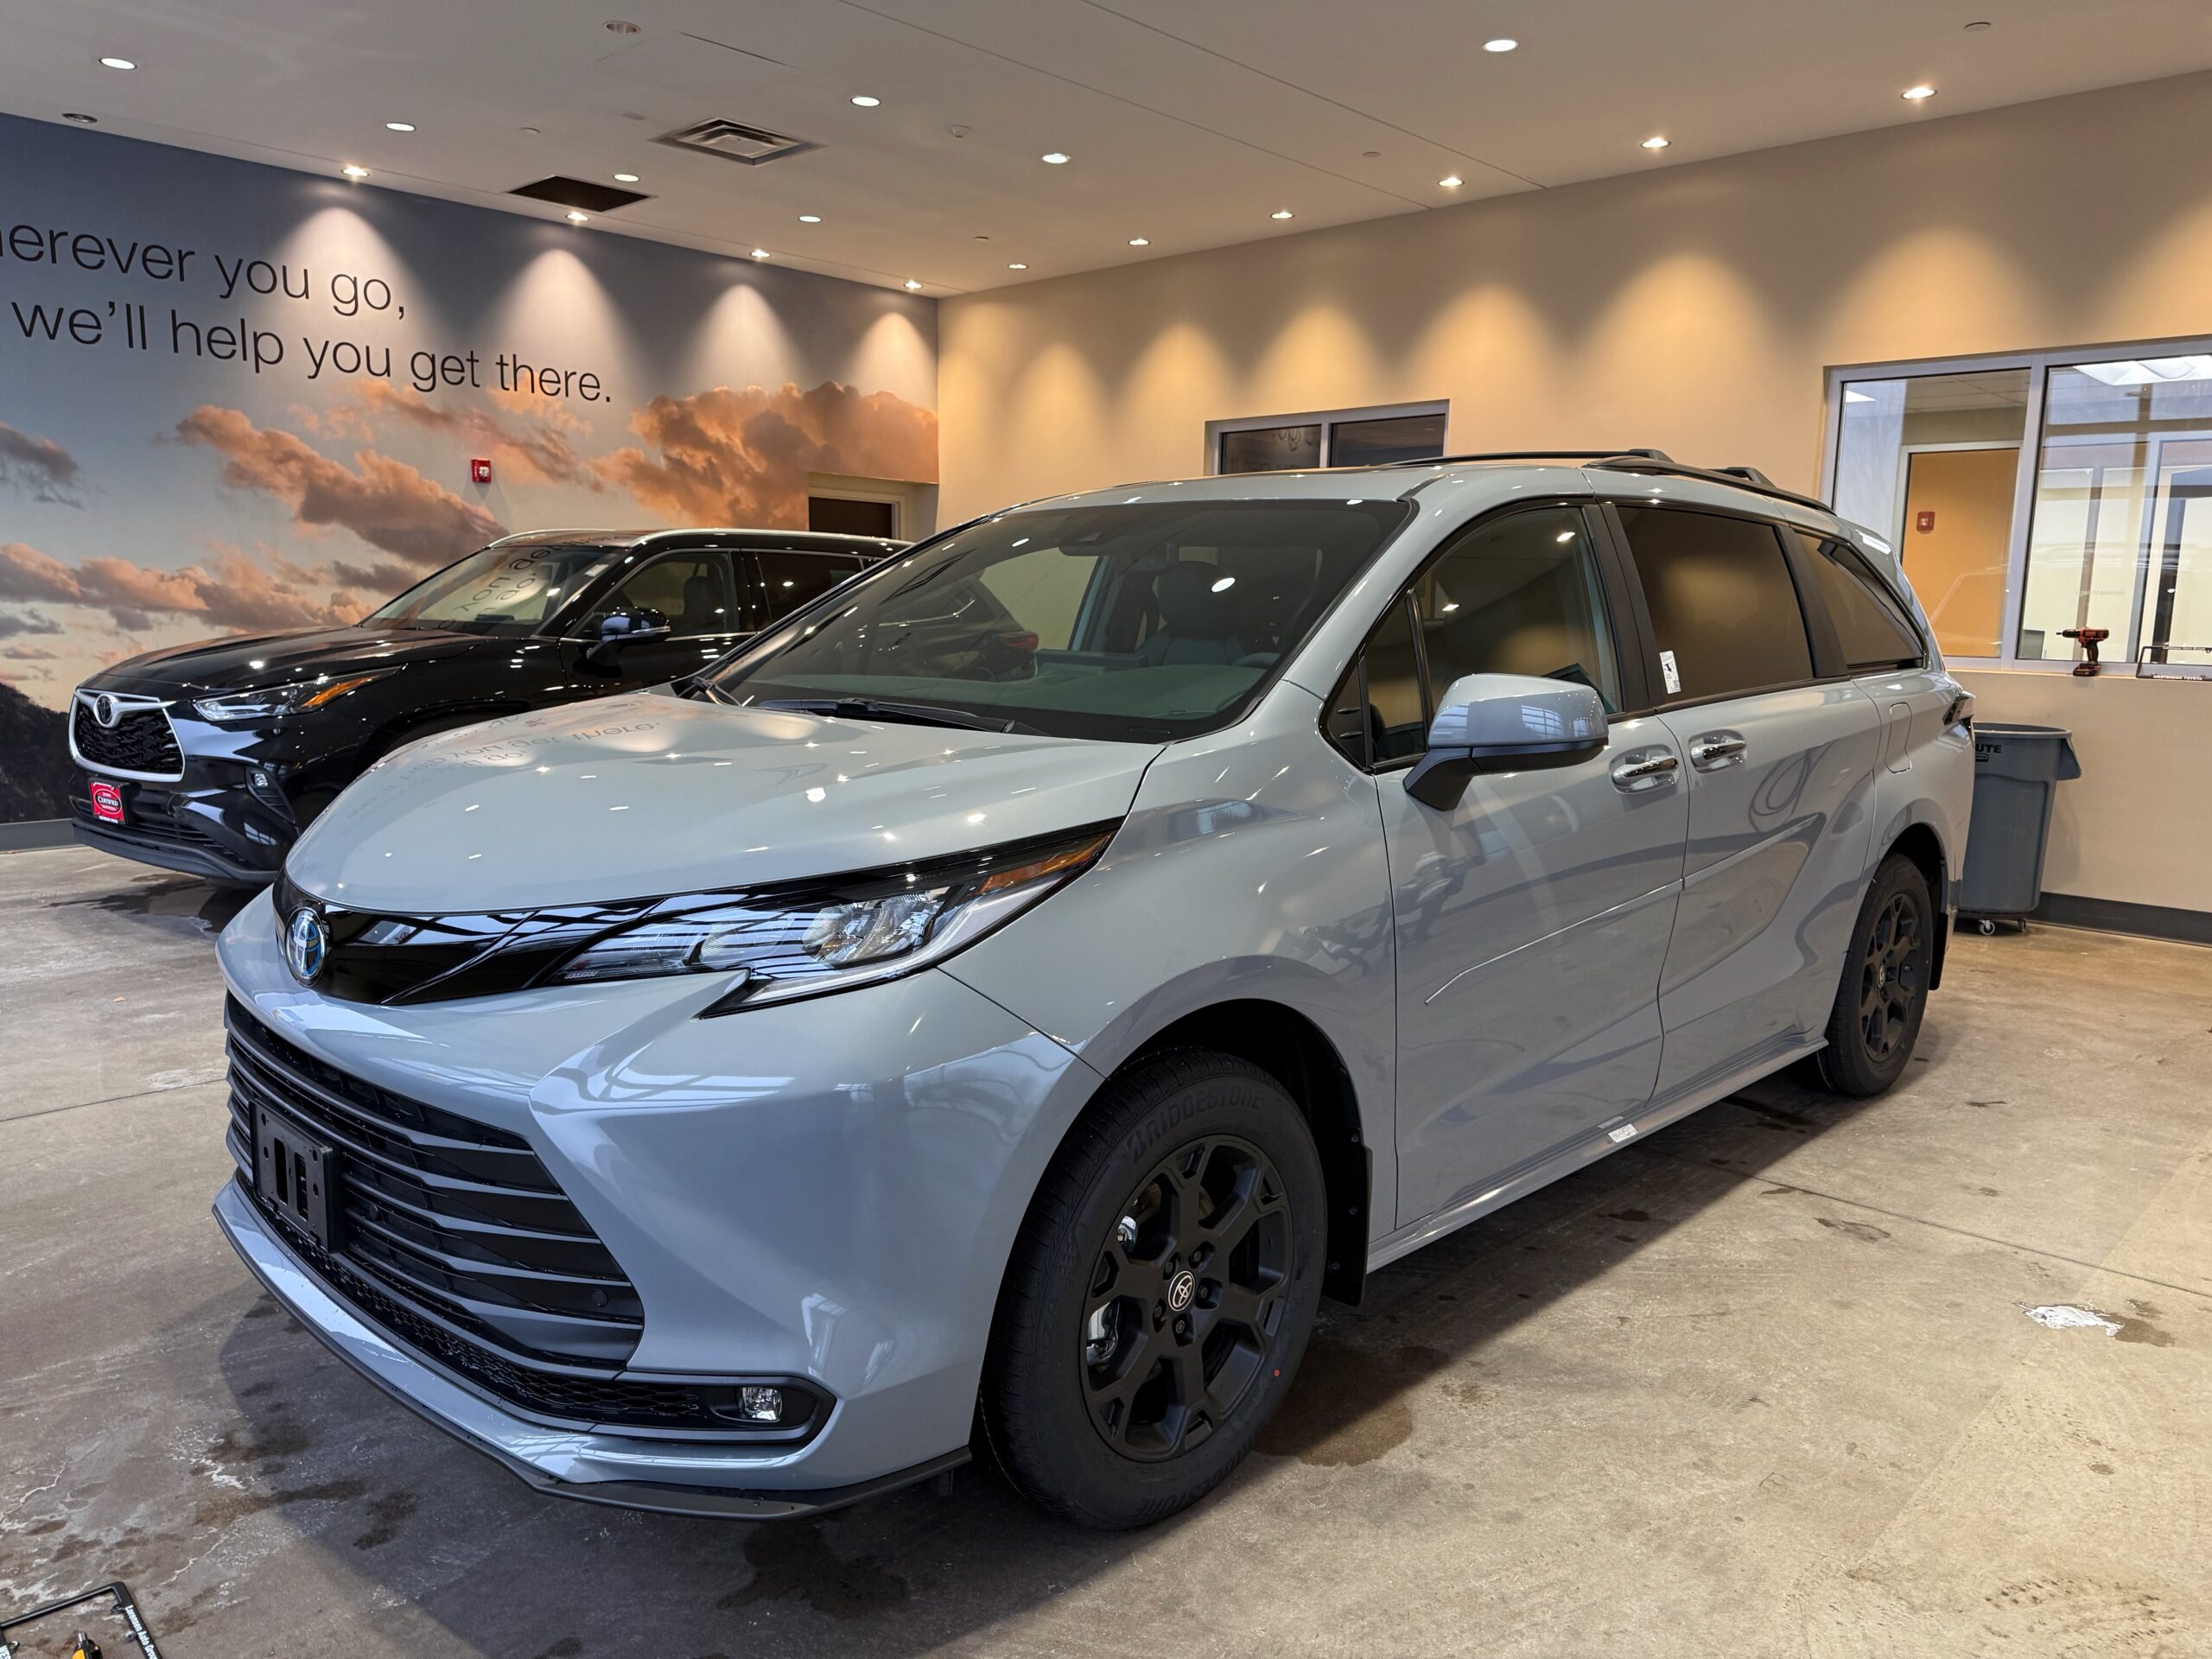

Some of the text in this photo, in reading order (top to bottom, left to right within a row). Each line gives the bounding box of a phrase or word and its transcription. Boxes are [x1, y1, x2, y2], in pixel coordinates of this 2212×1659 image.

[0, 225, 406, 320] erever you go,
[10, 301, 612, 403] we’ll help you get there.
[1975, 743, 2002, 753] UTE
[1125, 1084, 1262, 1164] BRIDGESTONE
[144, 1644, 159, 1659] Grou
